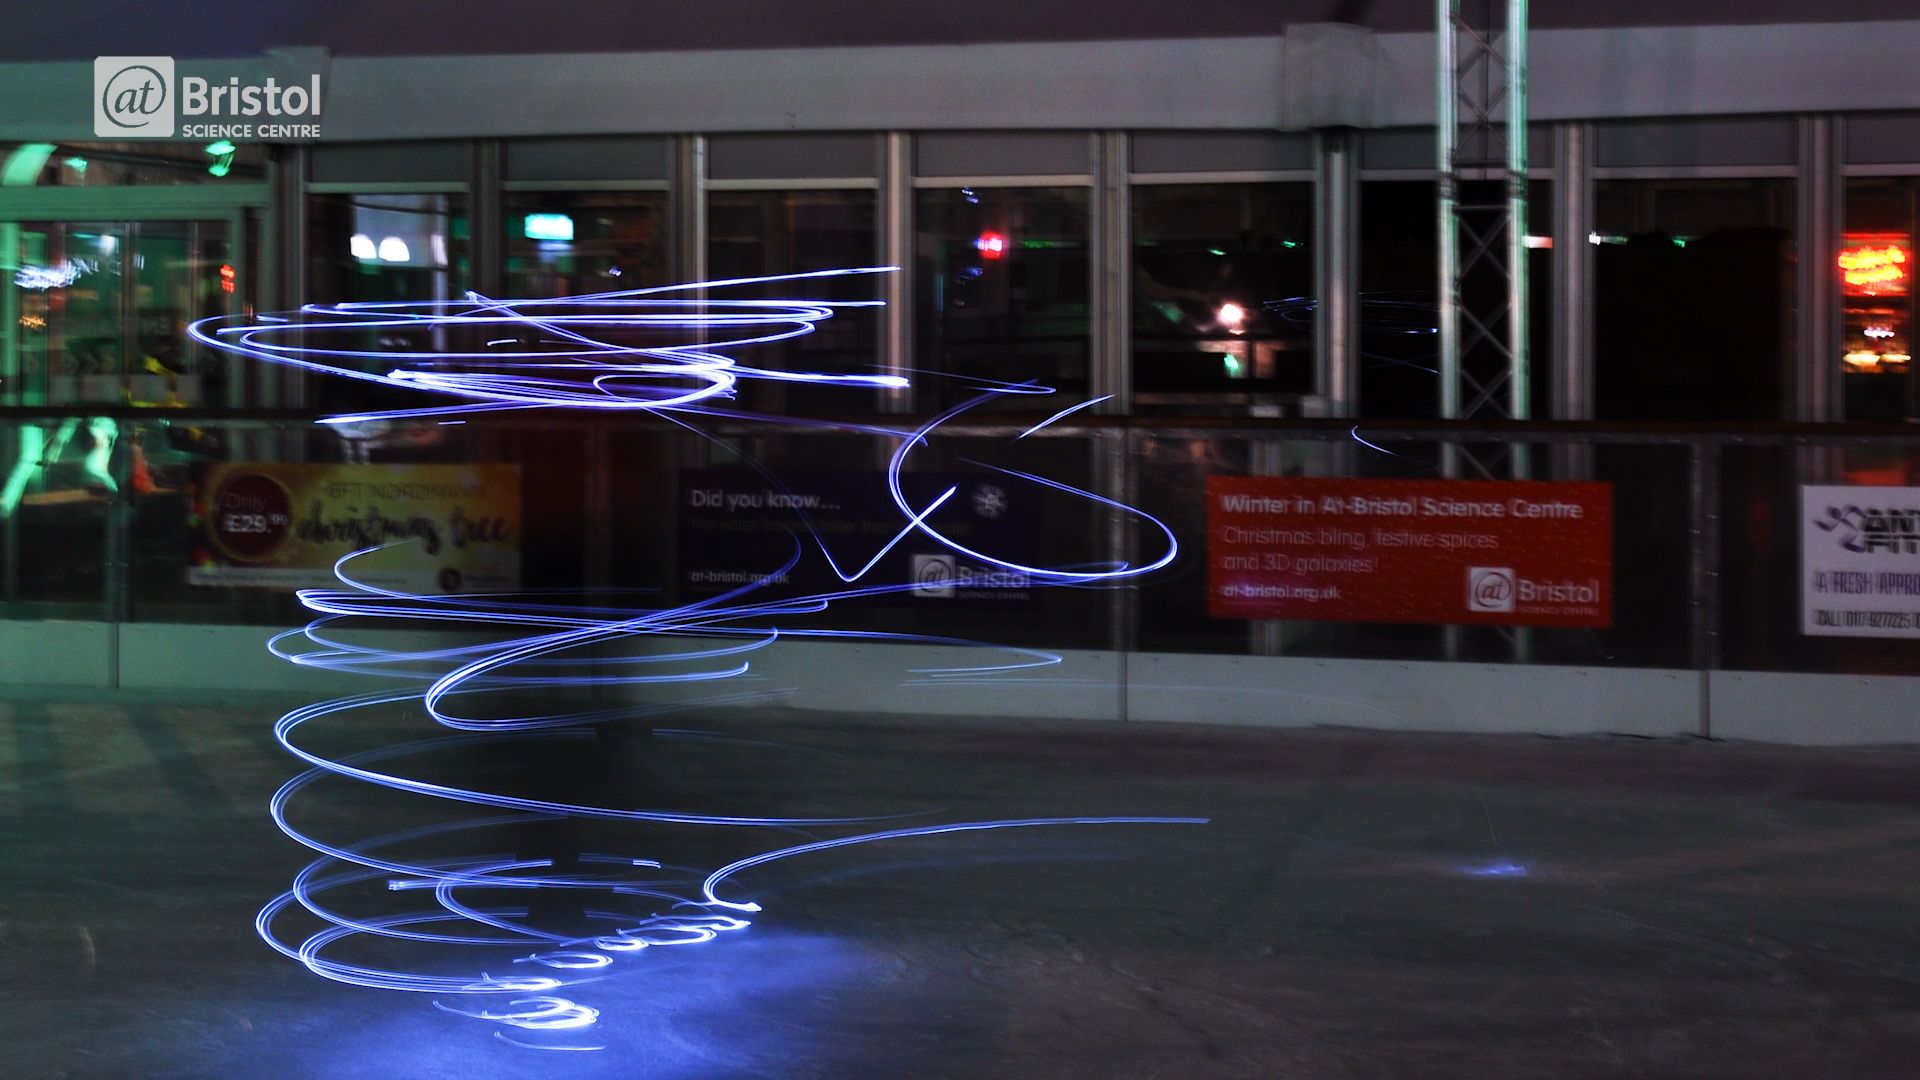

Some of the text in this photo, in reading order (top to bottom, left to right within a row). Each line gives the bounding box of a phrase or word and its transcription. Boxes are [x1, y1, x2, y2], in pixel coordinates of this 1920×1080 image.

[691, 489, 841, 512] Did you know...
[1221, 496, 1584, 520] Winter in At-Bristol Science Centre
[1222, 526, 1500, 552] Christmas bling, festive spices
[1223, 554, 1377, 576] and 3D galaxies!
[957, 566, 1031, 589] Bristol
[1814, 572, 1827, 593] A
[1832, 572, 1873, 594] FRESH
[1222, 585, 1341, 602] at-bristol.org.uk
[1518, 578, 1599, 603] Bristol
[1815, 610, 1841, 627] CALL
